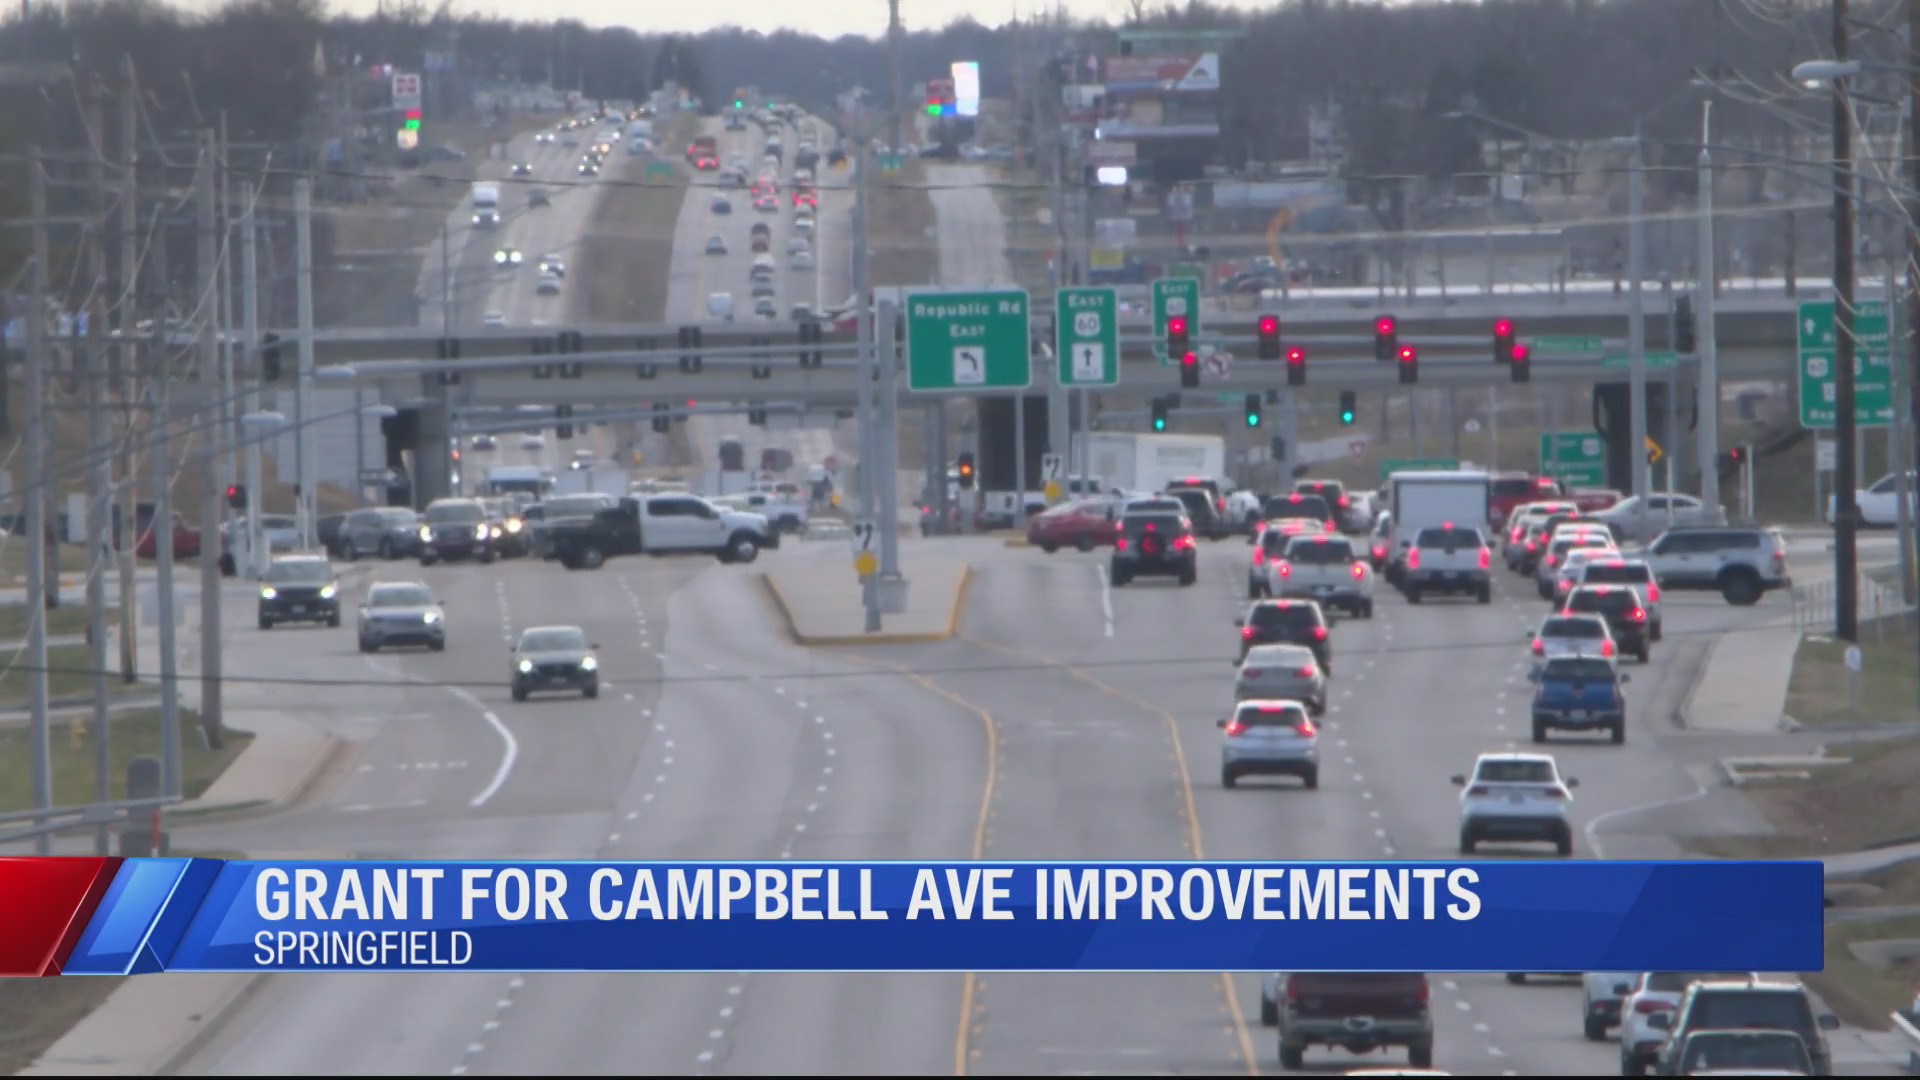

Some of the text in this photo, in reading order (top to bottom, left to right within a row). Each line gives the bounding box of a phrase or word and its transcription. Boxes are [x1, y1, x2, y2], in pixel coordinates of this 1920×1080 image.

[1068, 294, 1105, 308] EAST
[914, 300, 1021, 319] Republic Rd
[949, 324, 987, 337] EAST
[1077, 316, 1098, 331] 60
